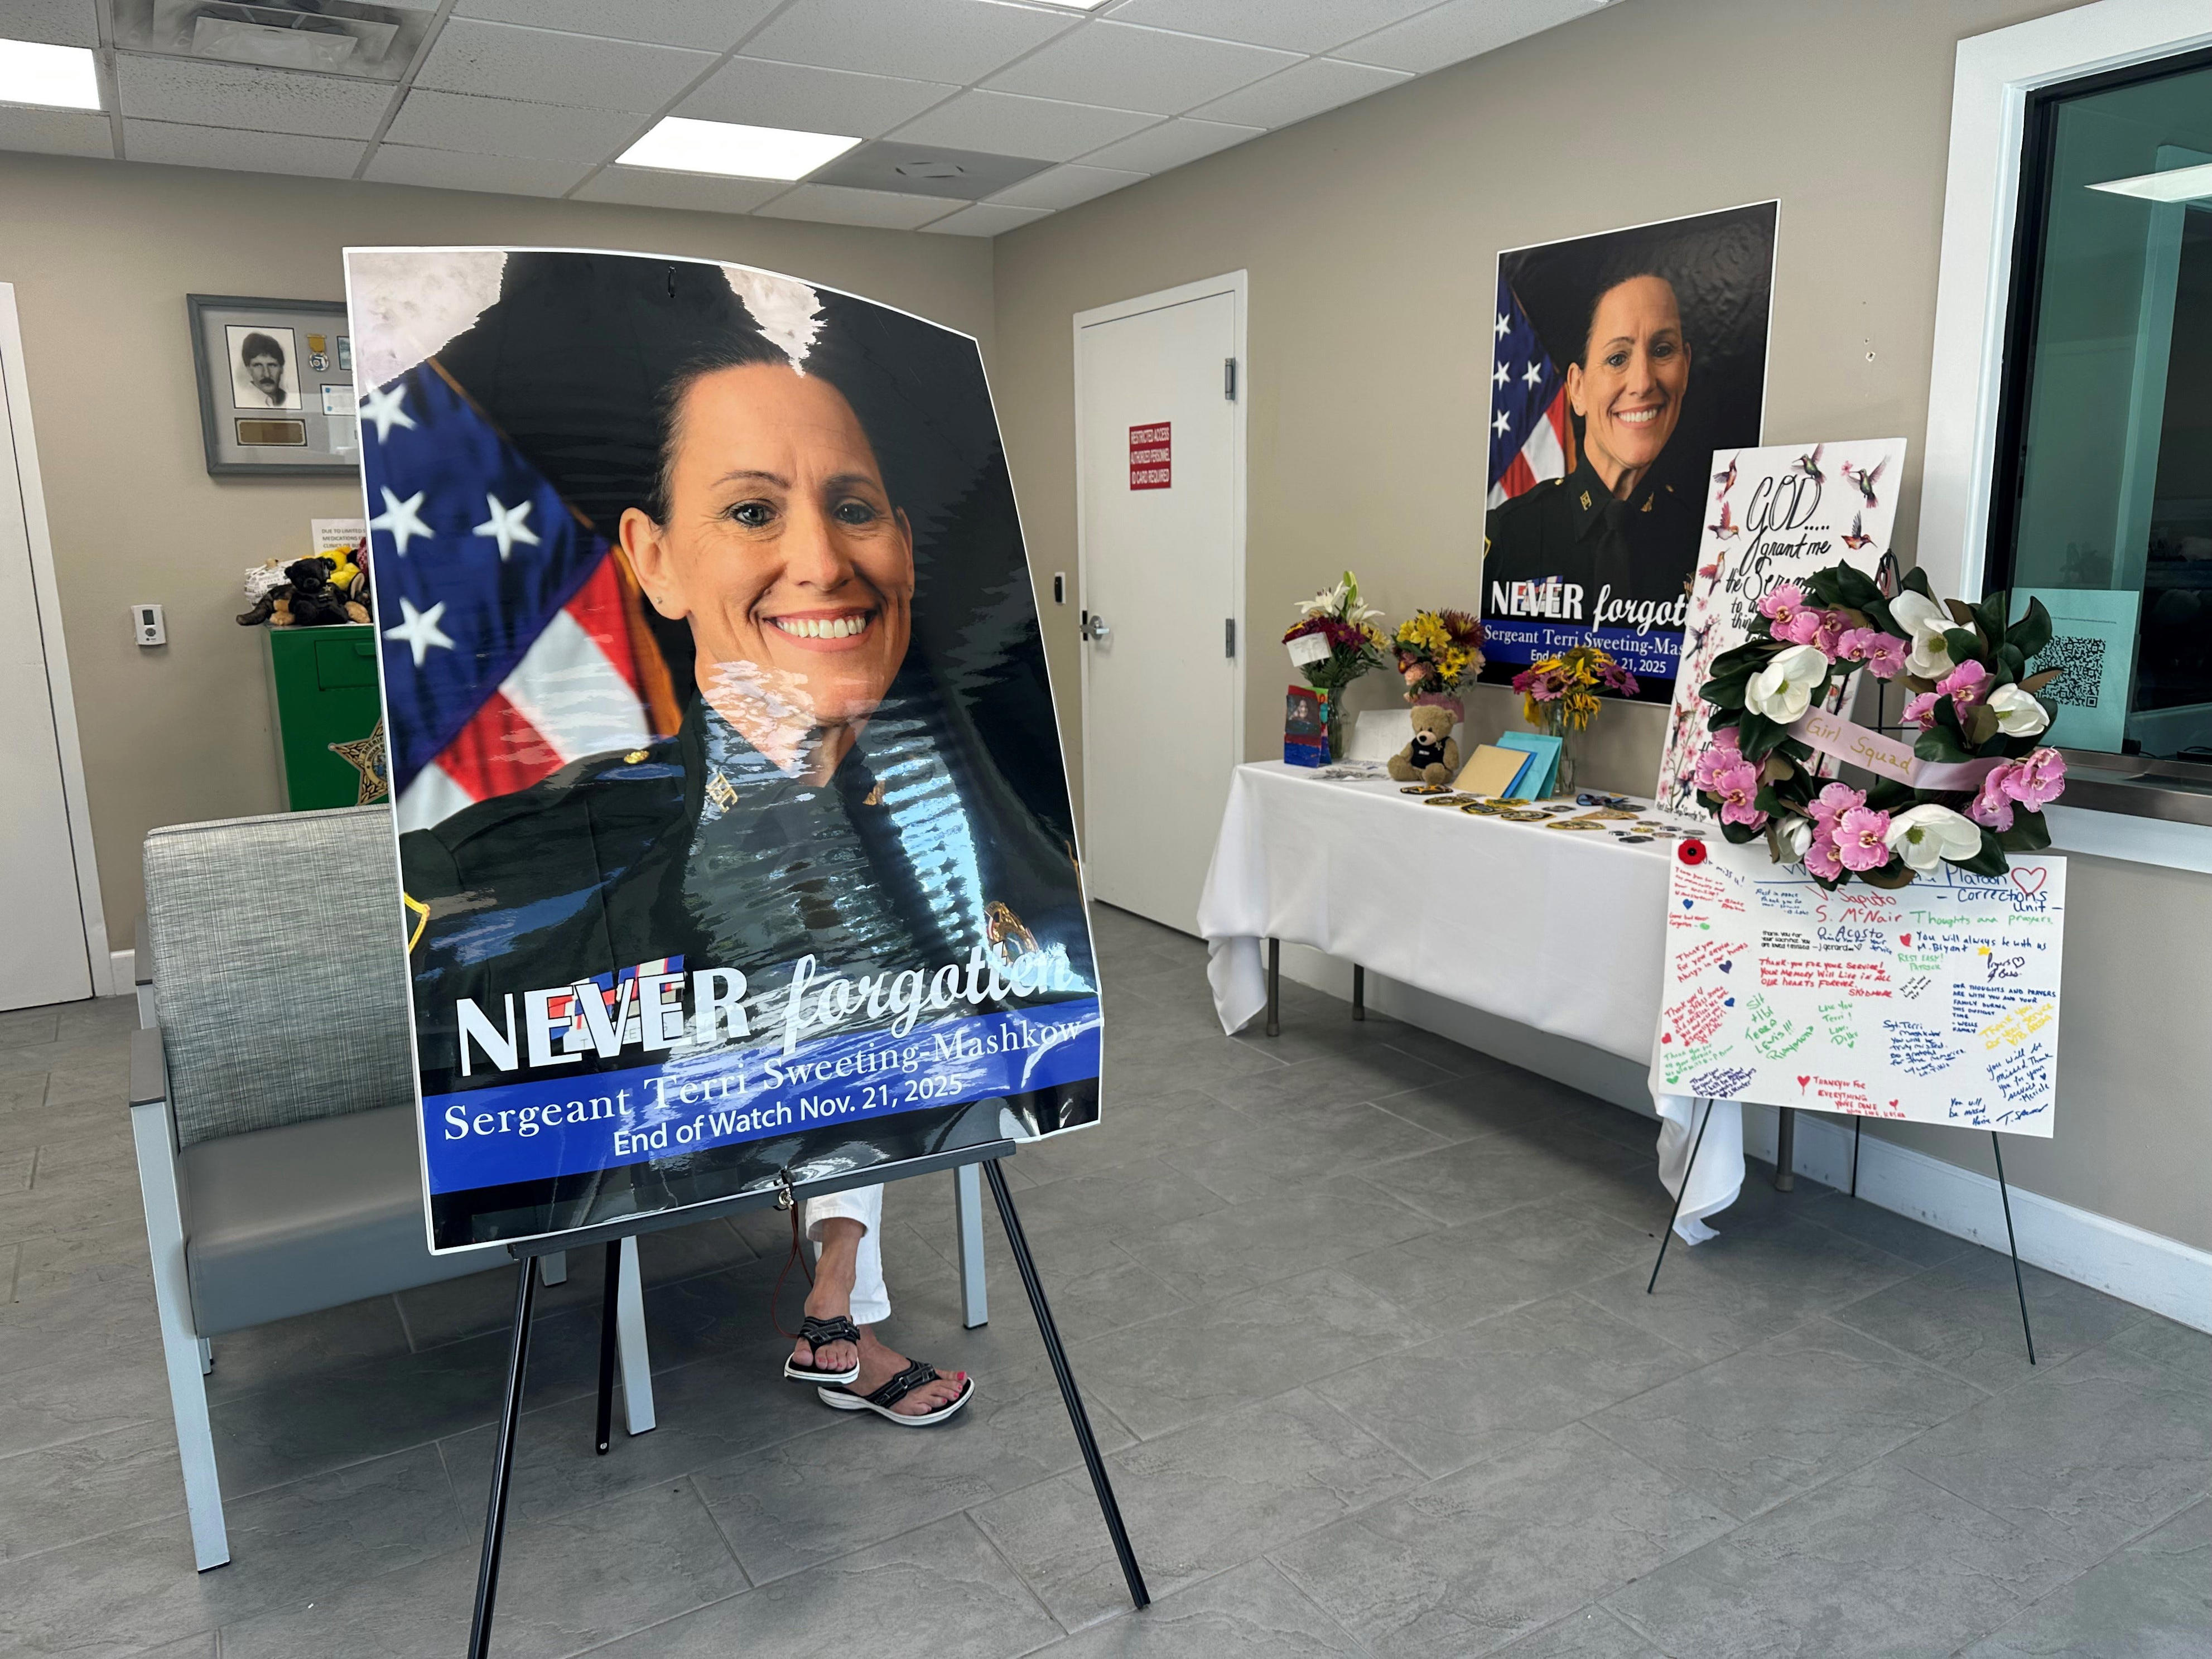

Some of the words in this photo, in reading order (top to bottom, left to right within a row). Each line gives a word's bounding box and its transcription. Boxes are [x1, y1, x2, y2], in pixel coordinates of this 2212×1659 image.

[1154, 427, 1169, 442] ACCESS
[1137, 470, 1148, 484] CARD
[1148, 469, 1169, 483] REQUIRED
[1761, 533, 1806, 558] grant
[1807, 542, 1833, 556] me
[1726, 567, 1743, 593] the
[1491, 580, 1584, 620] NEVER
[1731, 597, 1742, 614] to
[1485, 625, 1539, 644] Sergeant
[1543, 629, 1579, 646] Terri
[1531, 649, 1551, 662] End
[1622, 658, 1637, 672] 21,
[1639, 660, 1667, 674] 2025
[1806, 717, 1842, 743] Girl
[1850, 736, 1912, 775] Squad
[1945, 863, 2007, 887] Platoon
[1756, 888, 1770, 896] Rest
[1958, 888, 2049, 903] Corrections
[1816, 905, 1833, 922] S.
[1839, 907, 1903, 923] McNair
[2013, 901, 2046, 913] Unit
[1910, 910, 1970, 927] Thoughts
[1917, 931, 1935, 942] You
[1964, 937, 1996, 947] always
[2013, 938, 2031, 947] with
[1676, 946, 1699, 961] Thank
[1702, 941, 1713, 952] you
[1898, 953, 1917, 962] REST
[1921, 953, 1944, 962] EASY!
[1678, 967, 1702, 983] Always
[1761, 978, 1778, 987] OUR
[1969, 985, 2004, 993] THOUGHTS
[2028, 989, 2056, 997] PRAYERS
[457, 964, 752, 1077] NEVER
[780, 942, 1075, 1058] forgotten
[1986, 1062, 2001, 1081] you
[2006, 1048, 2025, 1064] will
[444, 1089, 633, 1142] Sergeant
[643, 1072, 749, 1112] Terri
[762, 1018, 1083, 1092] Sweeting-Mashkow
[1818, 1089, 1868, 1101] EVERYTHING
[613, 1123, 668, 1156] End
[675, 1115, 703, 1146] of
[707, 1105, 793, 1137] Watch
[799, 1093, 857, 1122] Nov.
[862, 1085, 899, 1114] 21,
[904, 1073, 963, 1105] 2025
